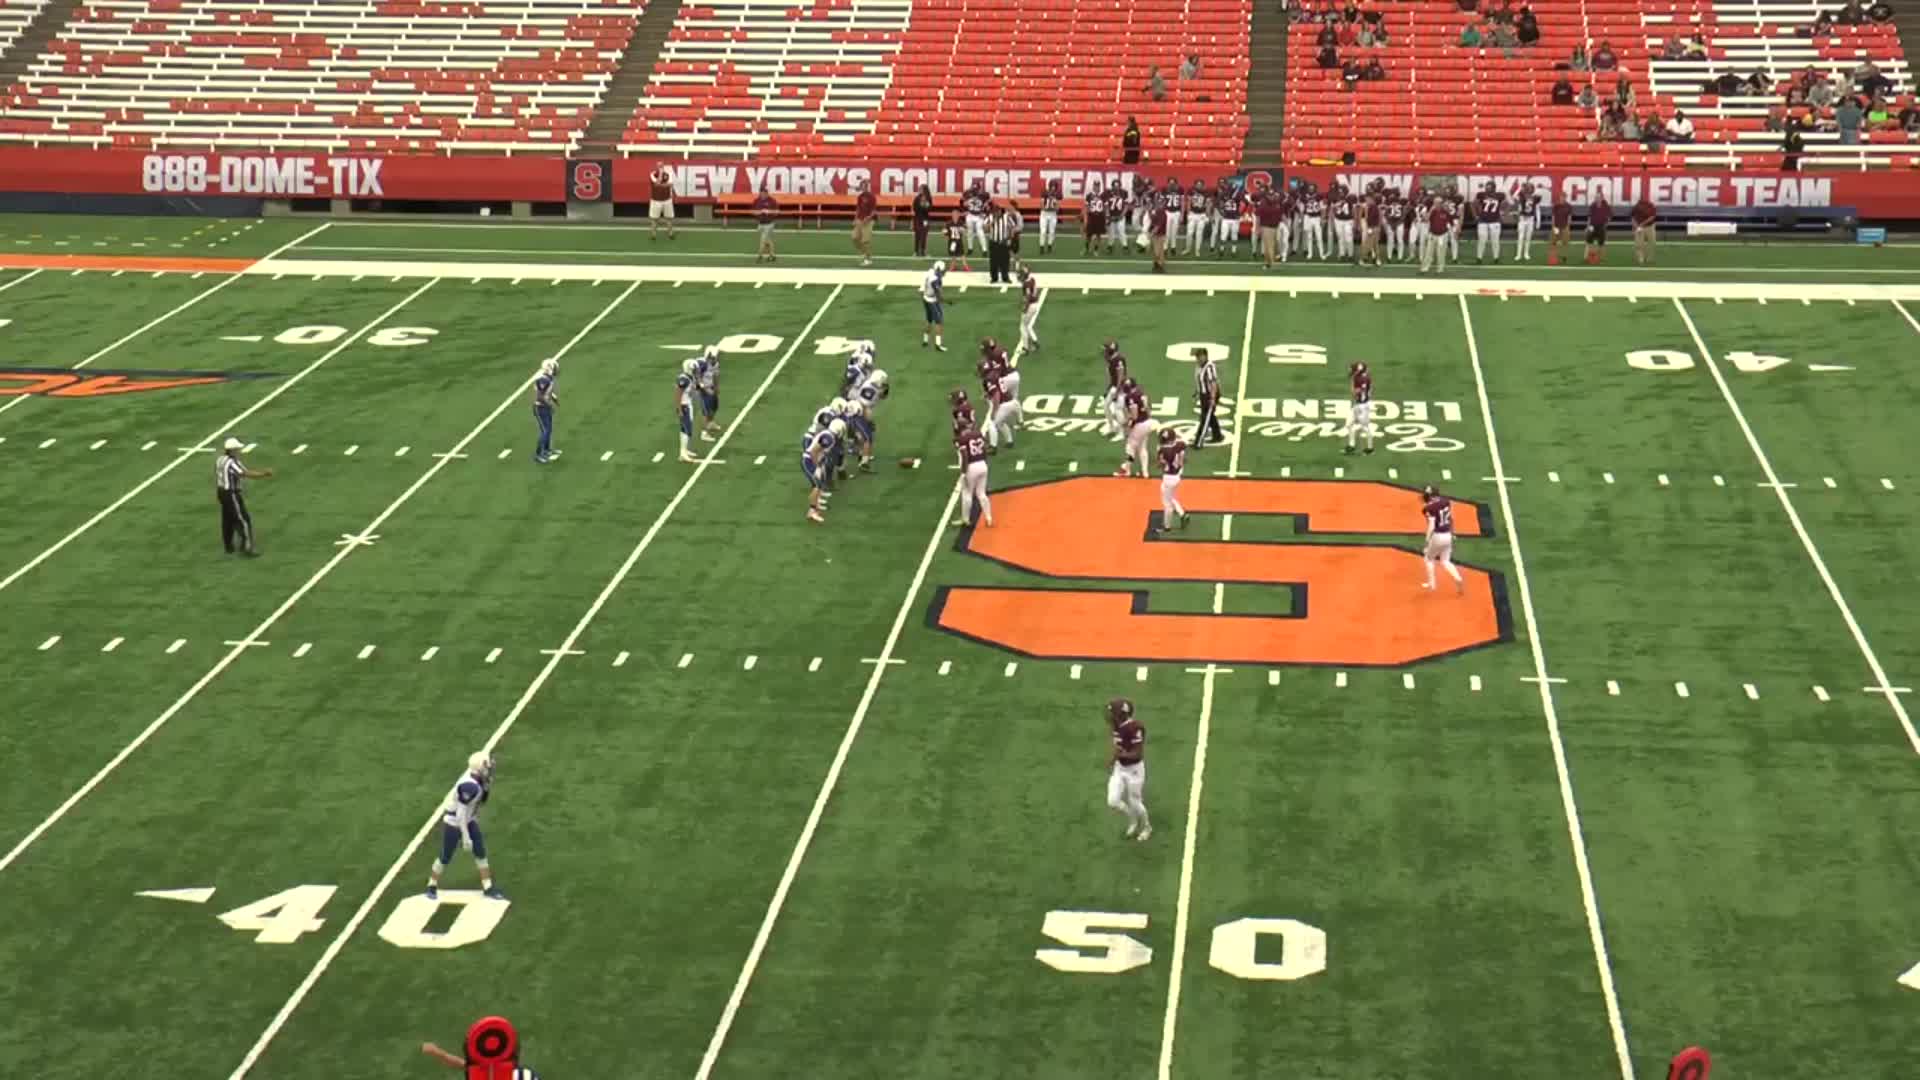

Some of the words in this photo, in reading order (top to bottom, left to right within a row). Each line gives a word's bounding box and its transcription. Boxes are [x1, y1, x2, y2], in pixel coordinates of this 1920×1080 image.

[142, 155, 383, 196] 888-DOME-TIX
[573, 162, 602, 199] S
[664, 165, 736, 197] NEW
[746, 167, 871, 196] YORK'S
[880, 168, 1031, 197] COLLEGE
[1482, 199, 1499, 213] 77
[1731, 177, 1831, 206] TEAM
[969, 437, 984, 456] 62
